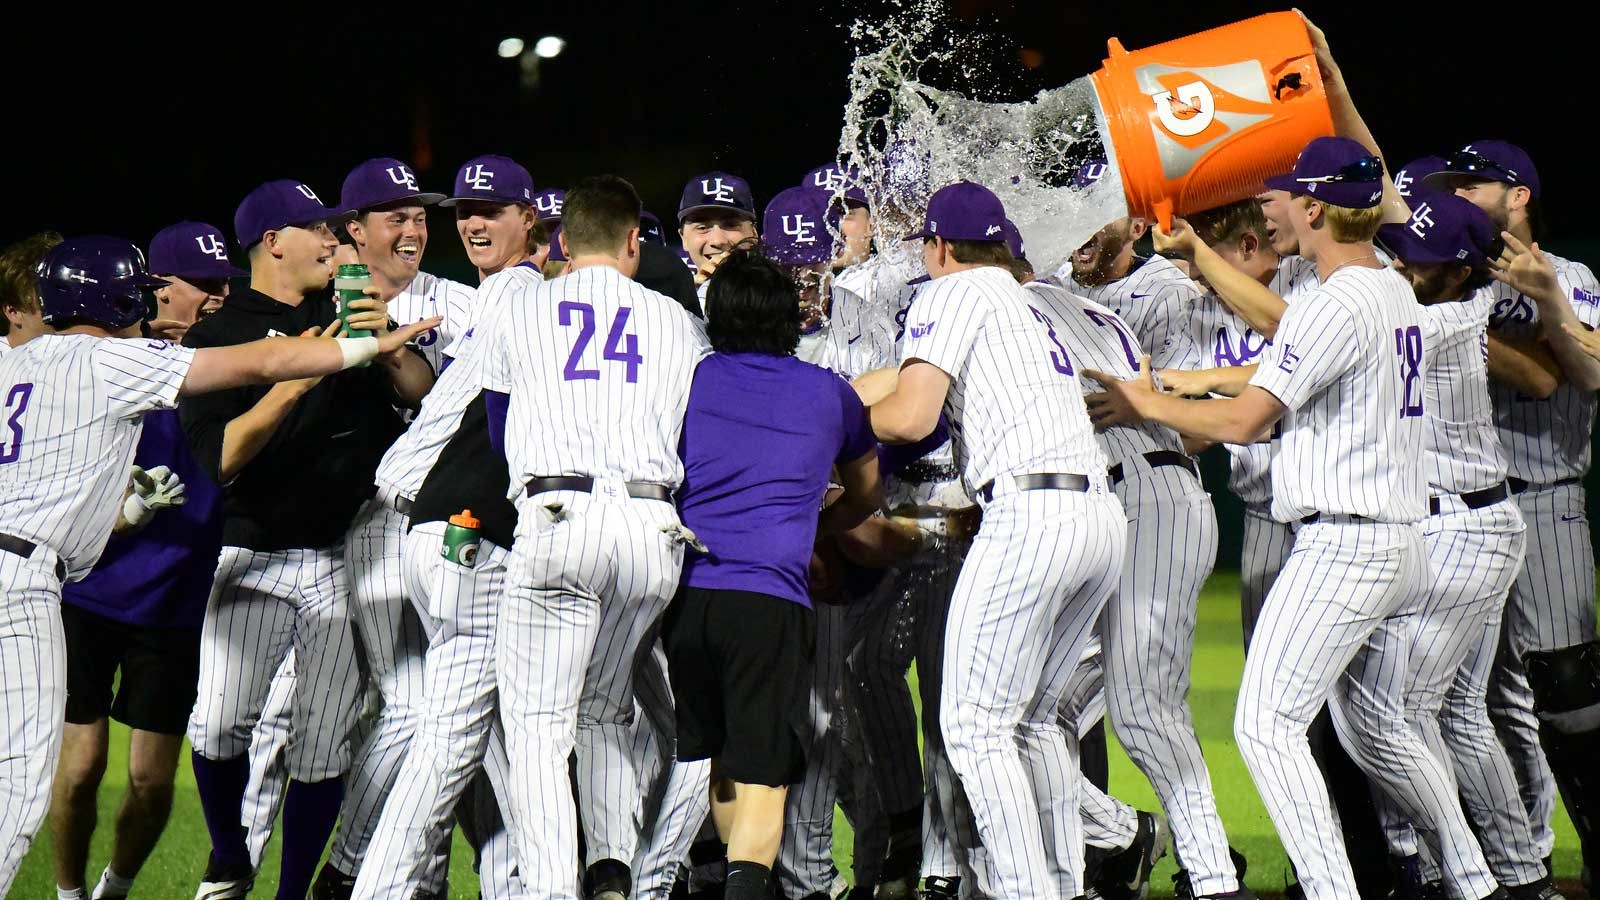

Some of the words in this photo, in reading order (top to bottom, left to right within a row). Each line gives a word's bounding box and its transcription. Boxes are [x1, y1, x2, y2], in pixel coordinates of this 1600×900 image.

[386, 166, 420, 191] UE
[465, 164, 494, 190] UE
[1087, 163, 1108, 179] U
[701, 178, 734, 203] UE
[535, 194, 563, 215] UE
[782, 214, 816, 243] UE
[1410, 202, 1436, 239] UE
[195, 234, 228, 261] UE
[558, 301, 643, 383] 24
[1278, 344, 1300, 374] UE
